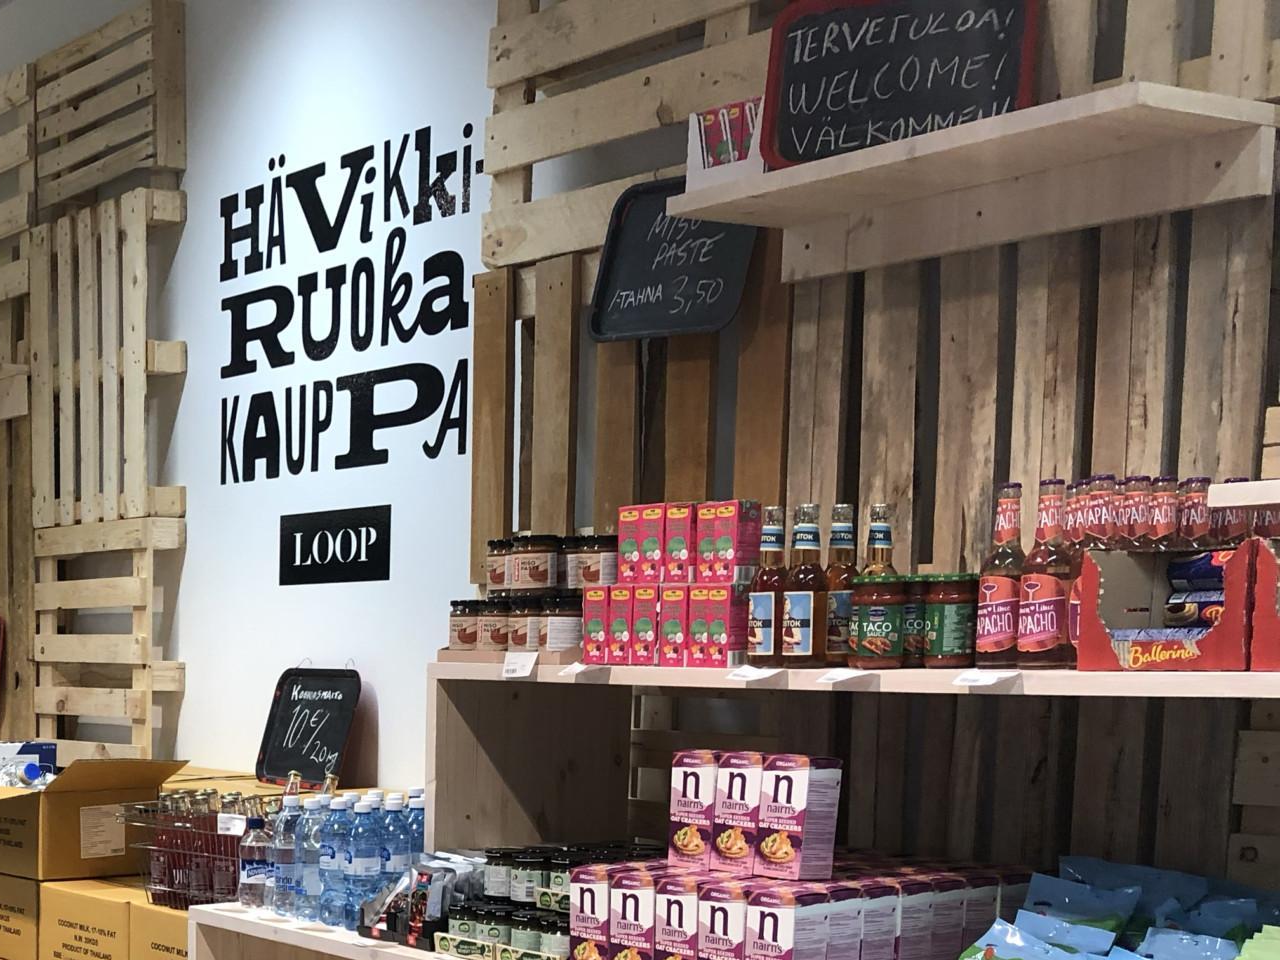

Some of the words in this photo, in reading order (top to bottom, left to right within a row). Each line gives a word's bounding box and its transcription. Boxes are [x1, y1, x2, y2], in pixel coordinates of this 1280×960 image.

[788, 9, 1015, 64] TERVETULOA!
[788, 52, 1007, 115] WELCOME!
[652, 232, 726, 270] PASTE
[668, 277, 723, 314] 3,50
[220, 358, 468, 485] KAUPPA
[292, 527, 377, 567] LOOP
[862, 622, 892, 632] TACO
[1129, 643, 1193, 667] Ballerina
[682, 770, 701, 799] n
[727, 772, 747, 801] n
[772, 775, 793, 805] n
[677, 799, 704, 810] nairn's
[722, 800, 750, 812] nairn's
[767, 805, 797, 816] nairn's
[681, 817, 711, 826] CRACKERS
[714, 817, 725, 825] OAT
[725, 819, 756, 828] CRACKERS
[770, 823, 802, 832] CRACKERS
[579, 887, 596, 915] n
[622, 892, 640, 922] n
[576, 914, 600, 925] nairn's
[666, 898, 684, 929] n
[710, 905, 729, 937] n
[58, 919, 78, 929] COCONUT
[107, 930, 116, 939] FAT
[617, 920, 644, 932] nairn's
[662, 926, 688, 939] nairn's
[758, 910, 779, 943] n
[580, 932, 606, 942] CRACKERS
[621, 939, 651, 949] CRACKERS
[705, 934, 734, 948] nairn's
[62, 943, 82, 953] PRODUCT
[90, 949, 112, 960] THAILAND
[151, 942, 175, 955] COCONUT
[666, 945, 694, 956] CRACKERS
[753, 940, 783, 954] nairn's
